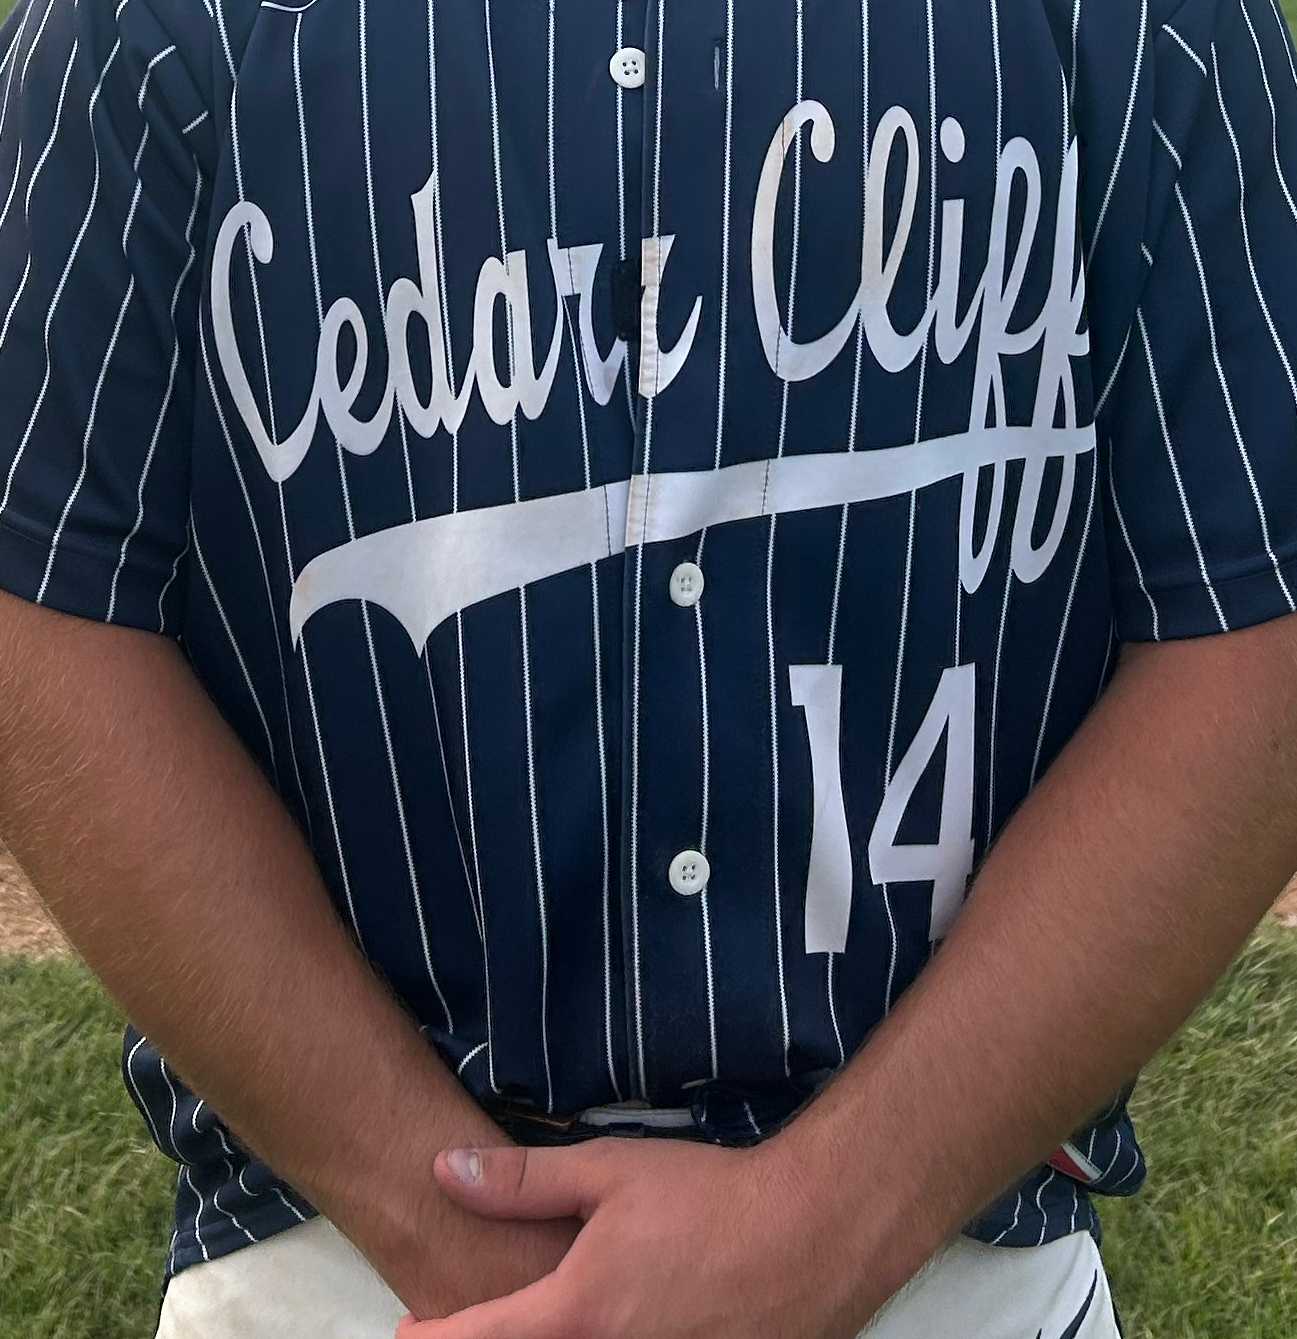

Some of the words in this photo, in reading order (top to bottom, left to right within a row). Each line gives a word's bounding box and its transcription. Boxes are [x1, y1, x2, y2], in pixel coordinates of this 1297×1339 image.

[210, 170, 702, 483] Cedar
[750, 99, 1092, 595] Cliff
[789, 662, 976, 954] 14
